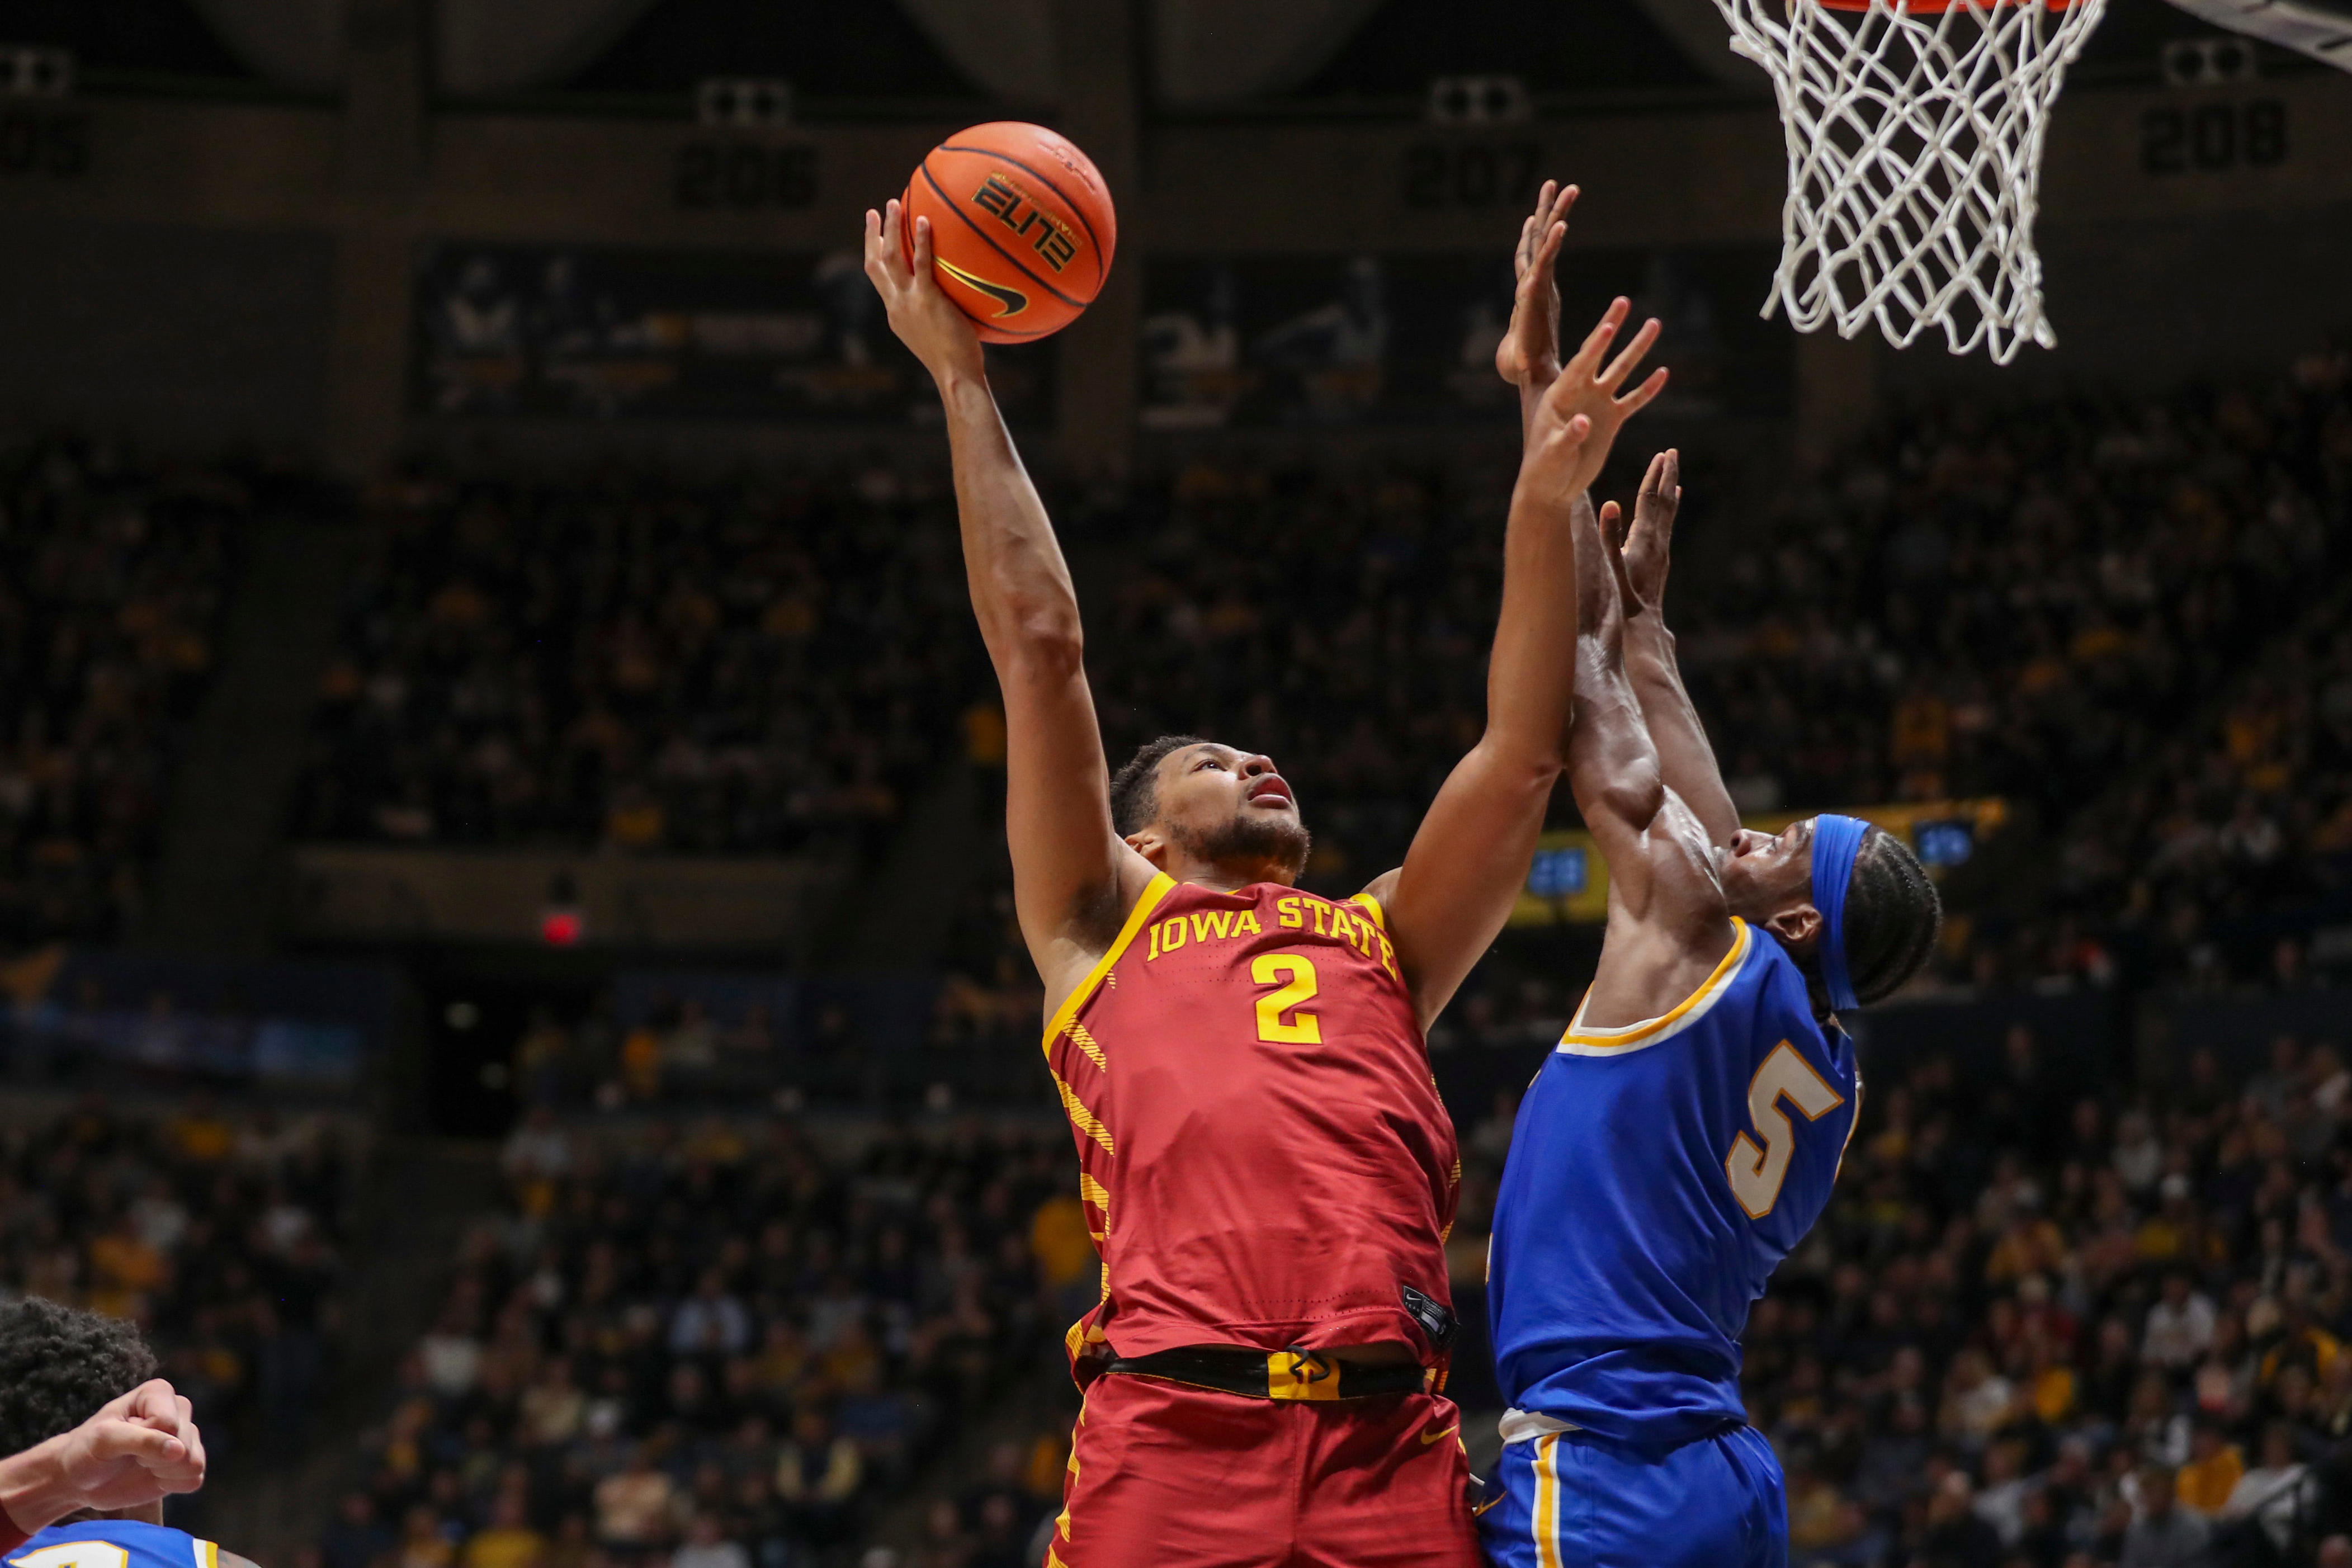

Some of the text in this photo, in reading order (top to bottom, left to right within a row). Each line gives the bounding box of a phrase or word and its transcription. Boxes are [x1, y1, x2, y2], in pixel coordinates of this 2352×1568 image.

[678, 144, 818, 208] 206
[1403, 141, 1543, 208] 207
[2141, 101, 2285, 173] 208
[971, 177, 1075, 273] ELITE
[1147, 897, 1397, 983] IOWA STATE
[1250, 953, 1323, 1045] 2
[1724, 1038, 1845, 1220] 5
